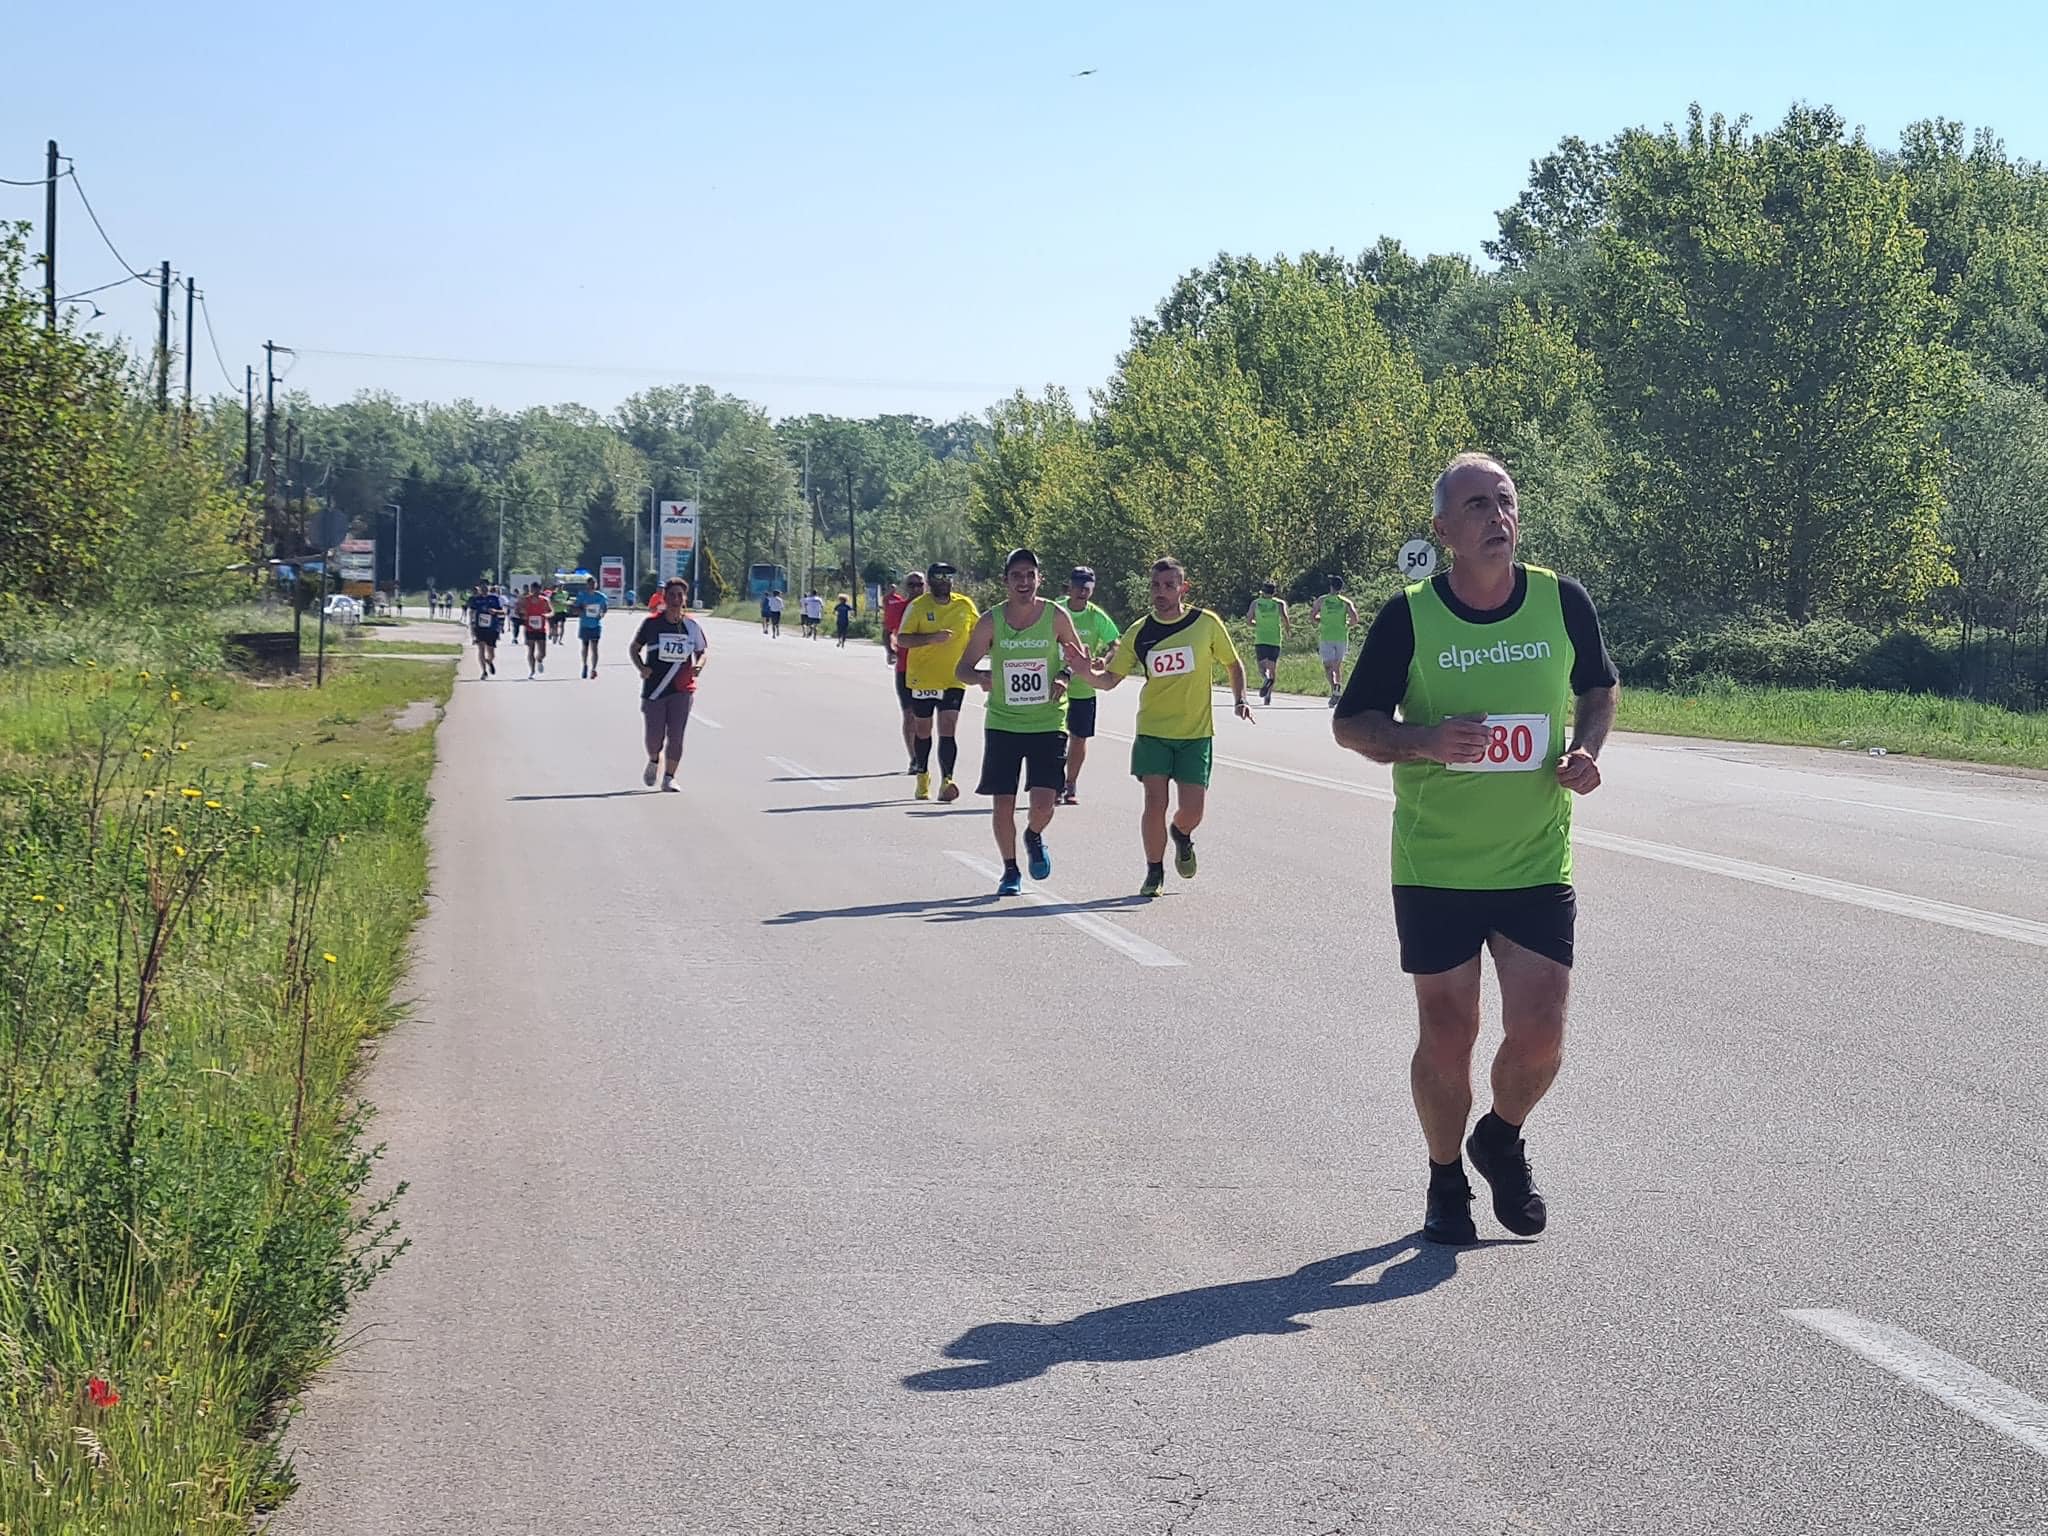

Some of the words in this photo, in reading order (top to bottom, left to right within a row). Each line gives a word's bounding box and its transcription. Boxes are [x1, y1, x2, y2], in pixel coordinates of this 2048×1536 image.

[1406, 551, 1428, 568] 50
[663, 641, 683, 655] 478
[1000, 638, 1049, 651] elpedison
[1154, 652, 1185, 673] 625
[1438, 639, 1551, 672] elpedison
[1011, 673, 1042, 692] 880
[1471, 724, 1533, 763] 80
